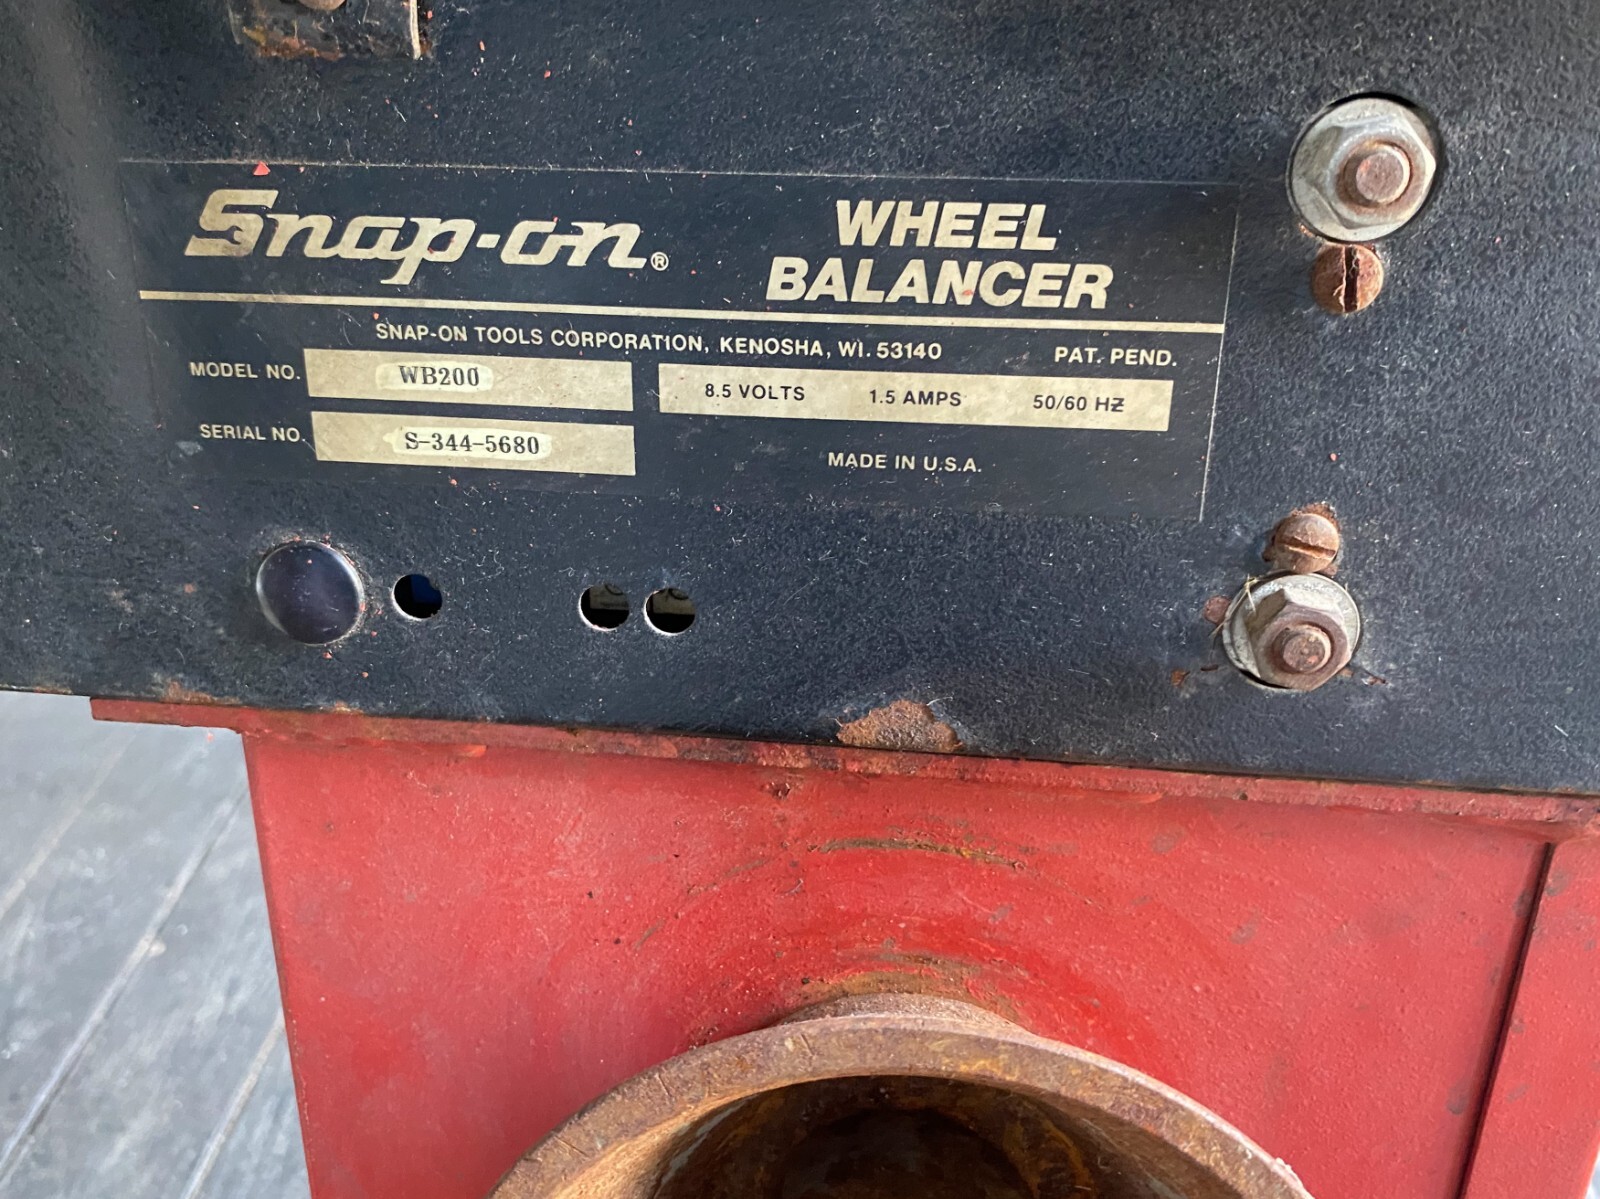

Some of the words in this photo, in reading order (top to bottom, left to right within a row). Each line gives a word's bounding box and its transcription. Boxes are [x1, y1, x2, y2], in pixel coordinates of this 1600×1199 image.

[836, 200, 1057, 251] WHEEL
[184, 188, 648, 286] Snap-on
[765, 256, 1114, 310] BALANCER
[375, 323, 468, 344] SNAP-ON
[474, 326, 543, 346] TOOLS
[550, 329, 710, 355] CORPORATION,
[719, 337, 832, 359] KENOSHA,
[837, 340, 871, 360] WI.
[876, 342, 942, 361] 53140
[1054, 346, 1104, 366] PAT.
[1110, 348, 1178, 368] PEND.
[189, 361, 258, 380] MODEL
[266, 364, 301, 382] NO.
[399, 365, 480, 387] WB200
[704, 383, 732, 400] 8.5
[738, 384, 805, 402] VOLTS
[869, 389, 895, 406] 1.5
[902, 391, 962, 408] AMPS
[1033, 395, 1088, 413] 50/60
[1095, 397, 1126, 414] HZ
[200, 424, 265, 441] SERIAL
[405, 432, 540, 456] S-344-5680
[828, 452, 887, 470] MADE
[896, 455, 915, 471] IN
[922, 456, 982, 474] U.S.A.
